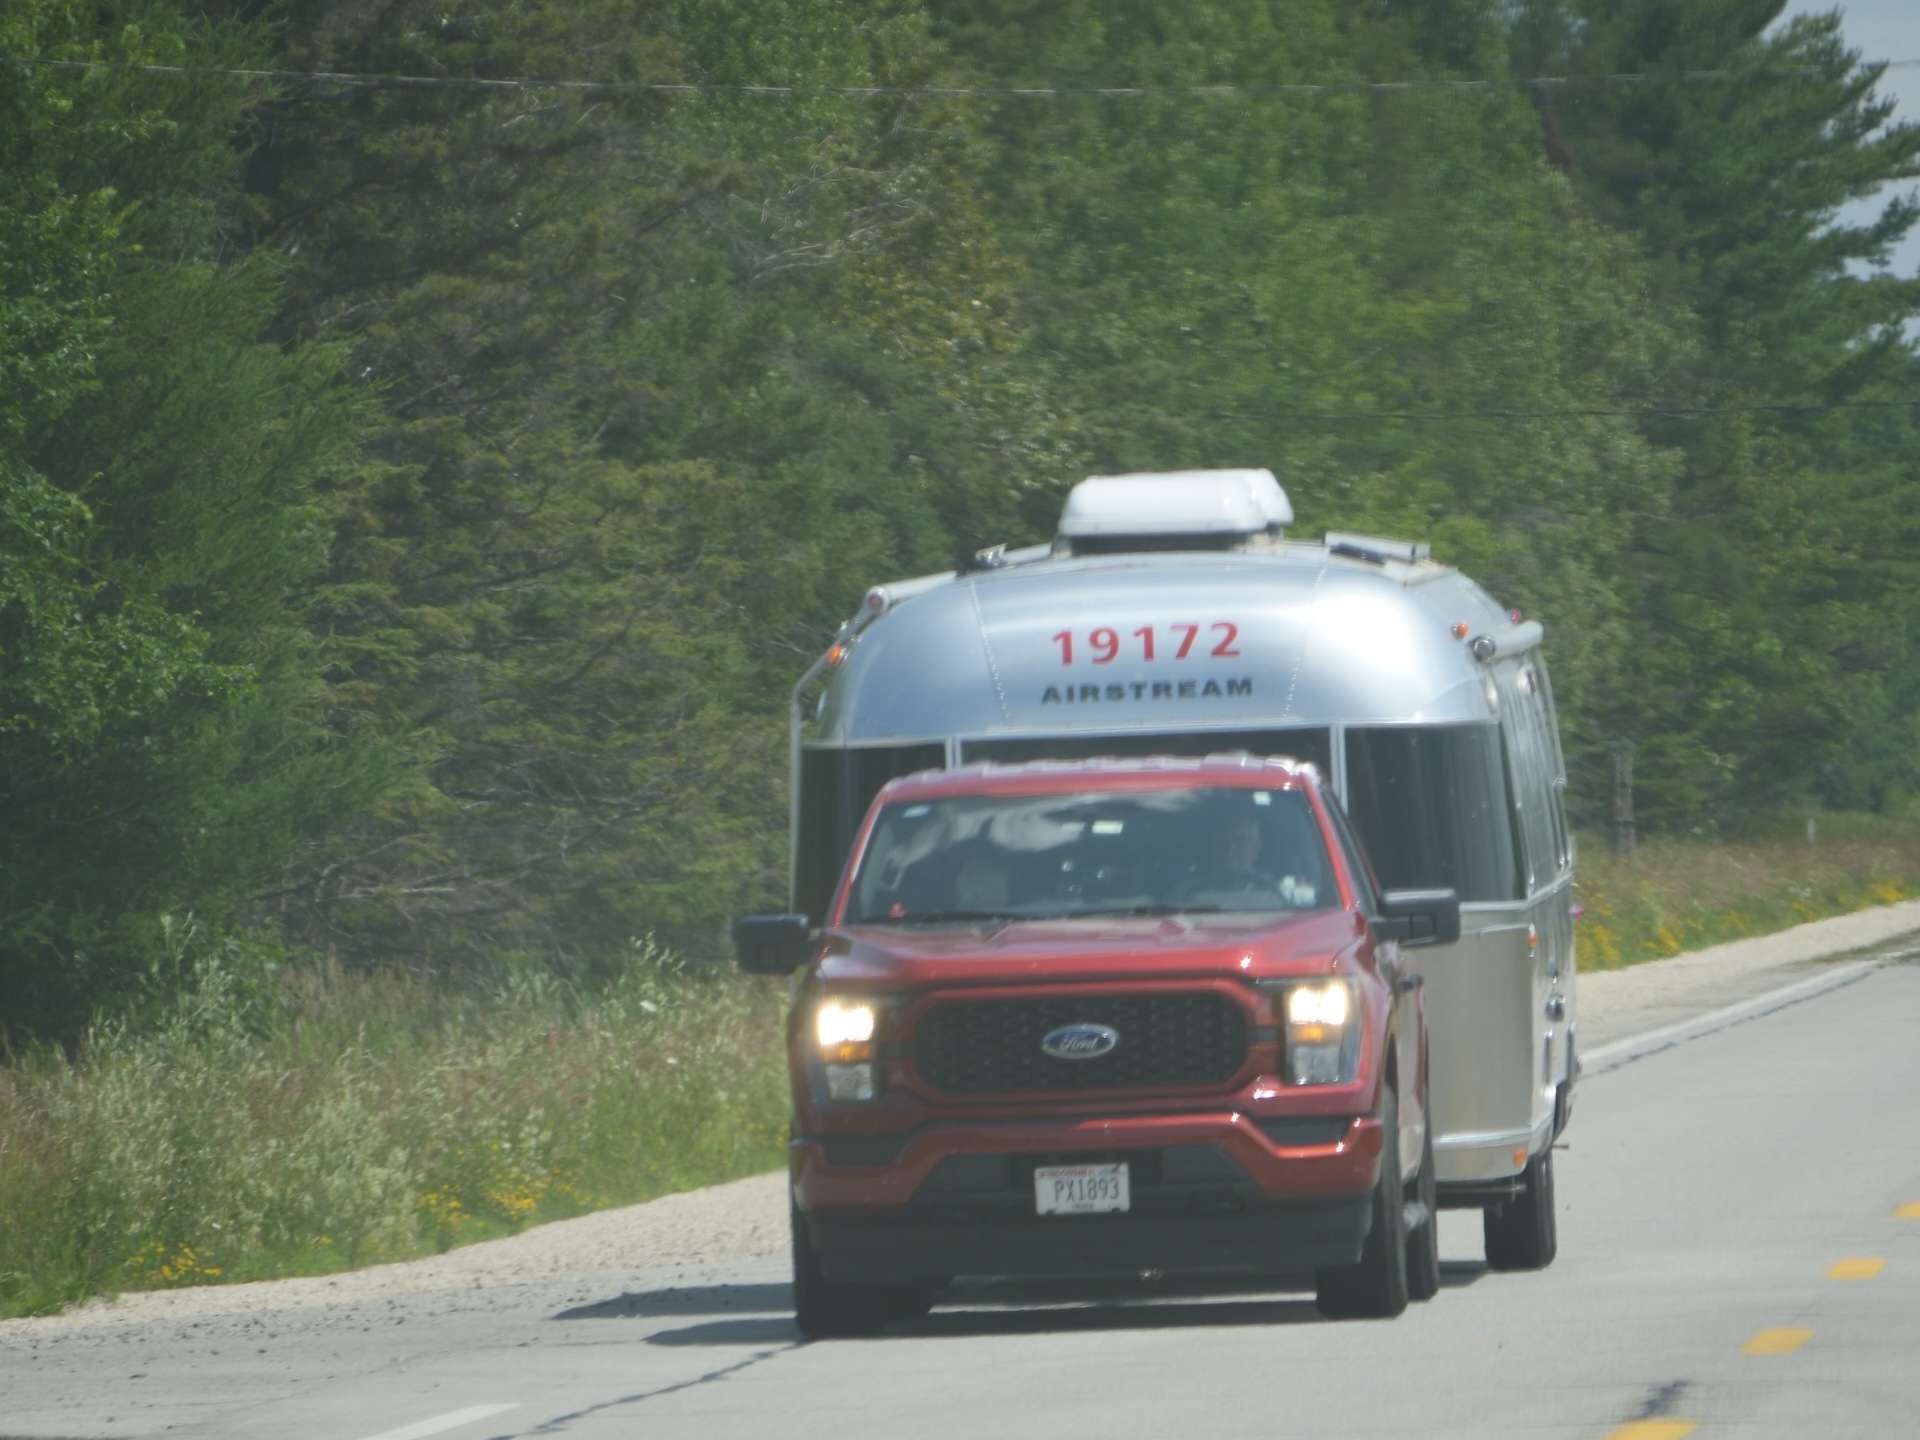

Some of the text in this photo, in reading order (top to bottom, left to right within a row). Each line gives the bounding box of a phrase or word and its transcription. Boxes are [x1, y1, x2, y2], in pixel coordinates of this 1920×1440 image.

[1051, 620, 1242, 667] 19172
[1041, 676, 1254, 705] AIRSTREAM
[1058, 1032, 1100, 1052] Ford
[1054, 1177, 1119, 1202] PX1893
